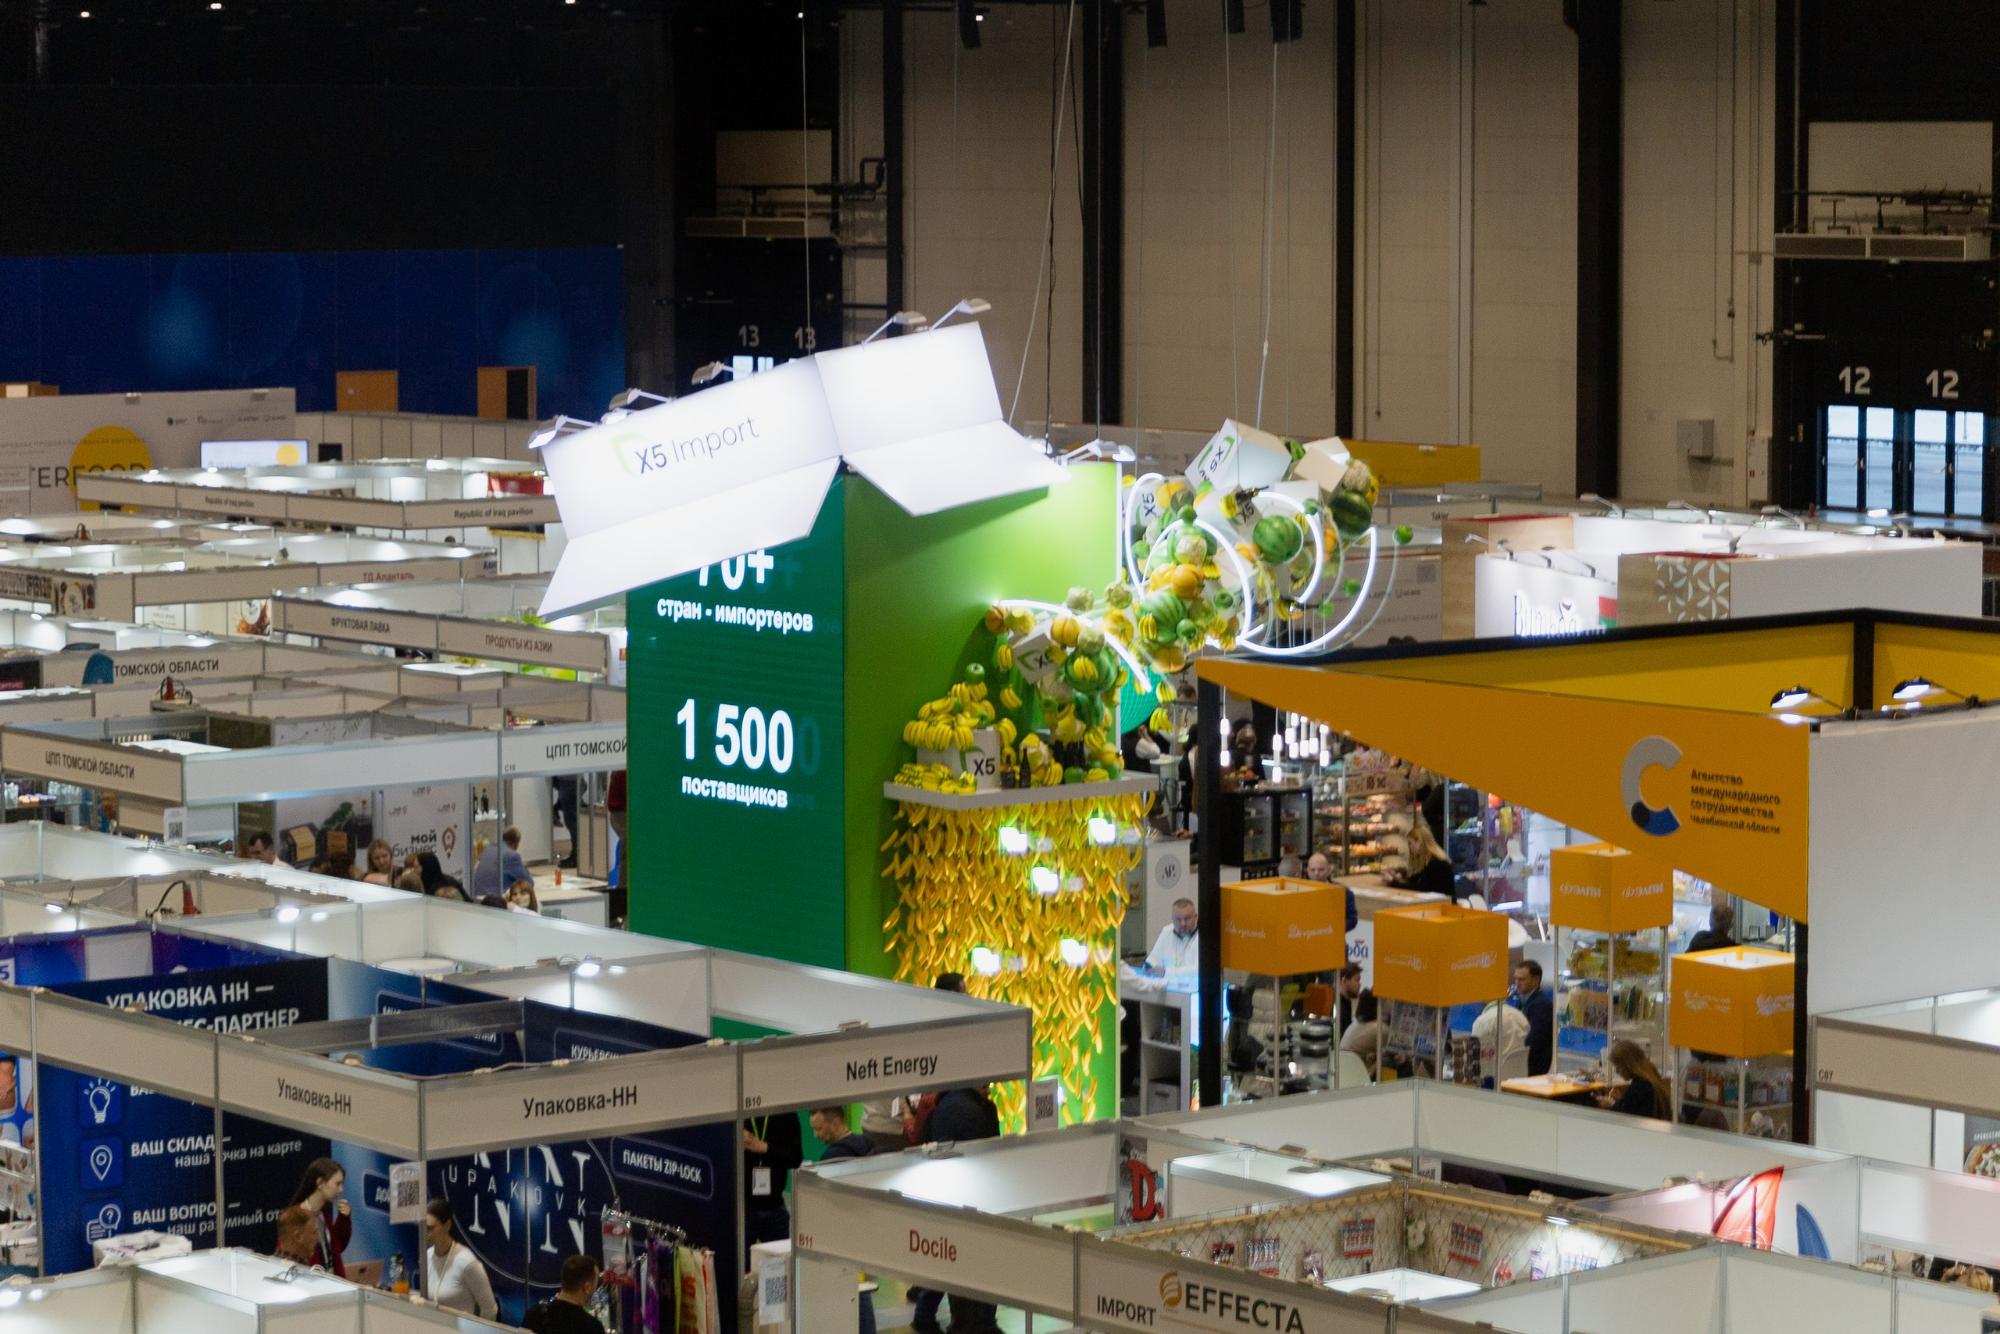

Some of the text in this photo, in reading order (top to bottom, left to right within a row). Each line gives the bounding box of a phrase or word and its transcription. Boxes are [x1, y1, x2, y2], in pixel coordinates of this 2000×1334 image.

[739, 325, 760, 347] 13
[795, 328, 816, 349] 13
[1838, 366, 1871, 395] 12
[1925, 369, 1959, 398] 12
[635, 417, 759, 474] X5 Import
[331, 616, 390, 633] ФРУКТОВАЯ ЛАВКА
[657, 598, 702, 623] стран
[715, 603, 814, 635] импортеров
[485, 634, 553, 653] ПРОДУКТЫ ИЗ АЗИИ
[115, 658, 219, 677] ТОМСКОЙ ОБЛАСТИ
[546, 743, 570, 761] ЦПП
[715, 703, 794, 774] 500
[45, 751, 135, 780] ЦПП ТОМСКОЙ ОБЛАСТИ
[974, 758, 996, 776] X5
[681, 775, 788, 809] поставщиков
[1690, 799, 1774, 820] сотрудничества
[221, 981, 249, 1004] НН
[846, 1054, 938, 1081] Neft Energy
[277, 1077, 351, 1116] Упаковка-НН
[524, 1084, 638, 1120] Упаковка-НН
[131, 1139, 163, 1157] ВАШ
[167, 1133, 216, 1154] СКЛАД
[175, 1153, 210, 1168] наша
[250, 1145, 264, 1158] на
[267, 1139, 302, 1158] карте
[623, 1149, 702, 1185] ПАКЕТЫ ZIP-LOCK
[132, 1206, 166, 1225] ВАШ
[908, 1229, 958, 1263] Docile
[1096, 1282, 1306, 1334] IMPORT EFFECTA
